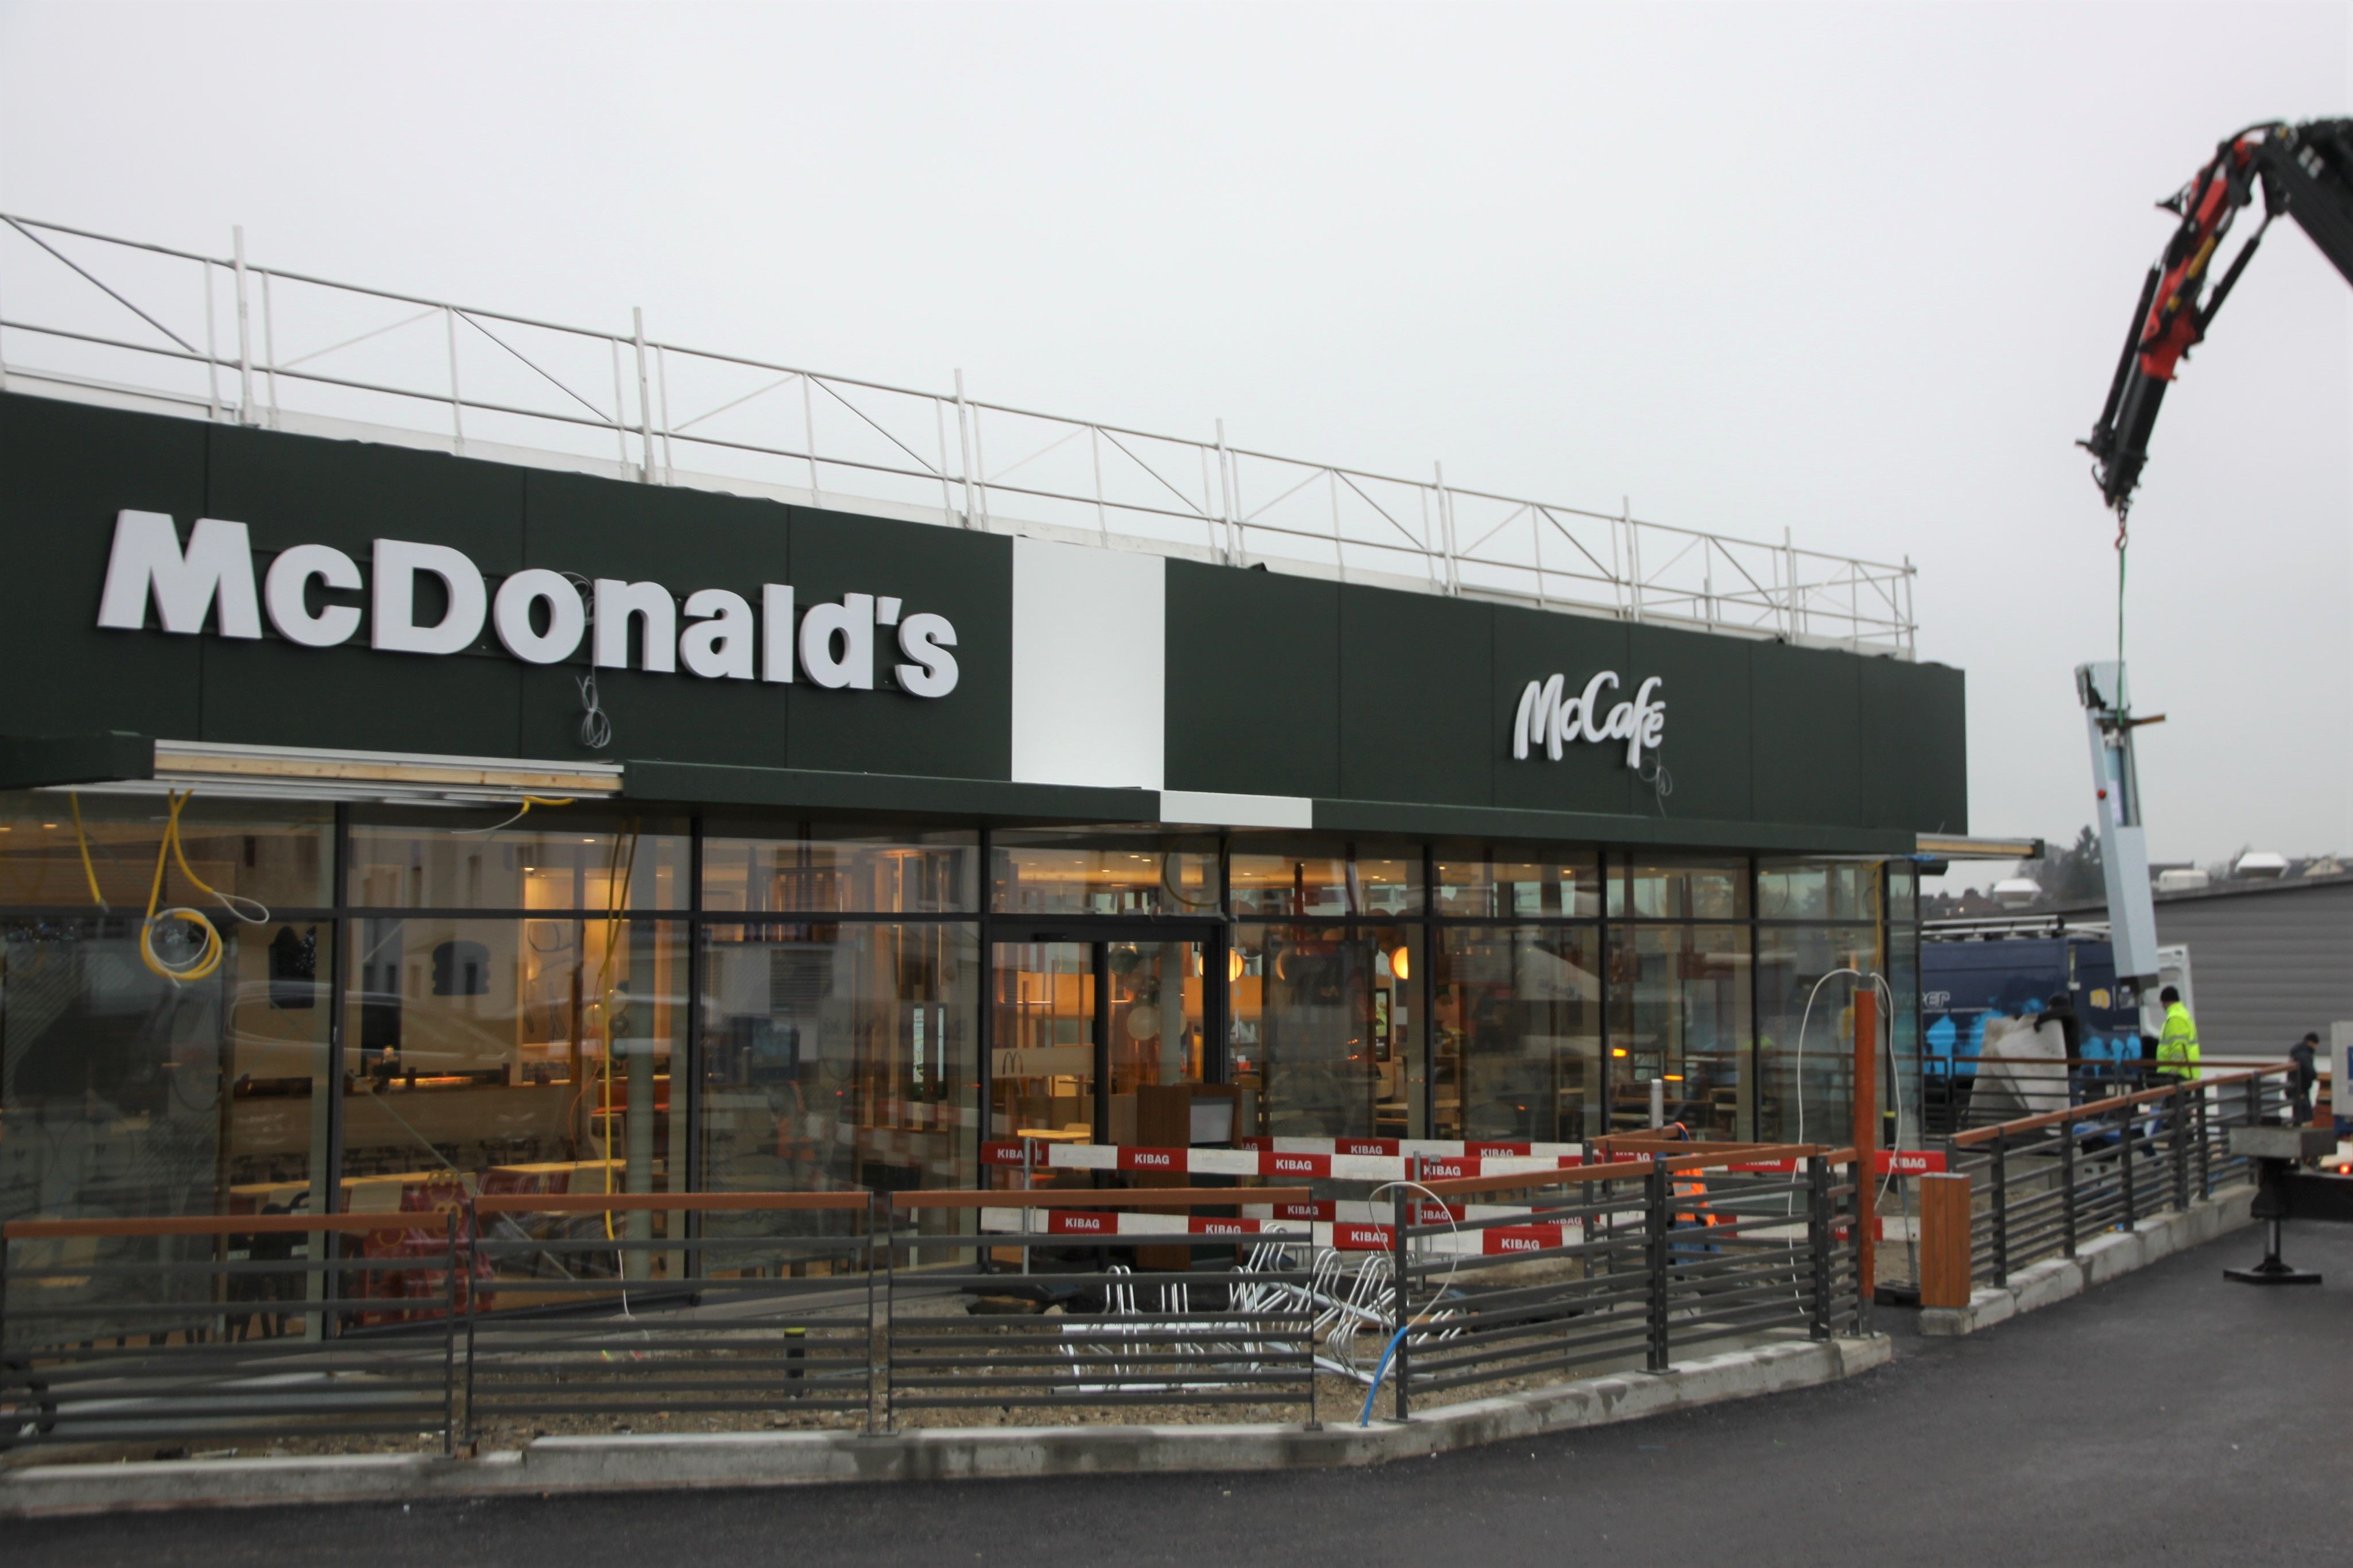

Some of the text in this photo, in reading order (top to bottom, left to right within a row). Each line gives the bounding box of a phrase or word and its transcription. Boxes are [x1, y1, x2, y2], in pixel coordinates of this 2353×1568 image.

[96, 509, 959, 698] McDonald's
[1514, 671, 1666, 769] McCafé
[997, 1148, 1025, 1159] KIBA
[1350, 1145, 1383, 1155] KIBAG
[1135, 1153, 1170, 1165] KIBAG
[1276, 1159, 1312, 1171] KIBAG
[1423, 1165, 1461, 1176] KIBAG
[1287, 1205, 1319, 1215] KIBAG
[1065, 1218, 1100, 1229] KIBAG
[1206, 1224, 1241, 1234] KIBAG
[1351, 1231, 1388, 1243] KIBAG
[1501, 1238, 1540, 1250] KIBAG
